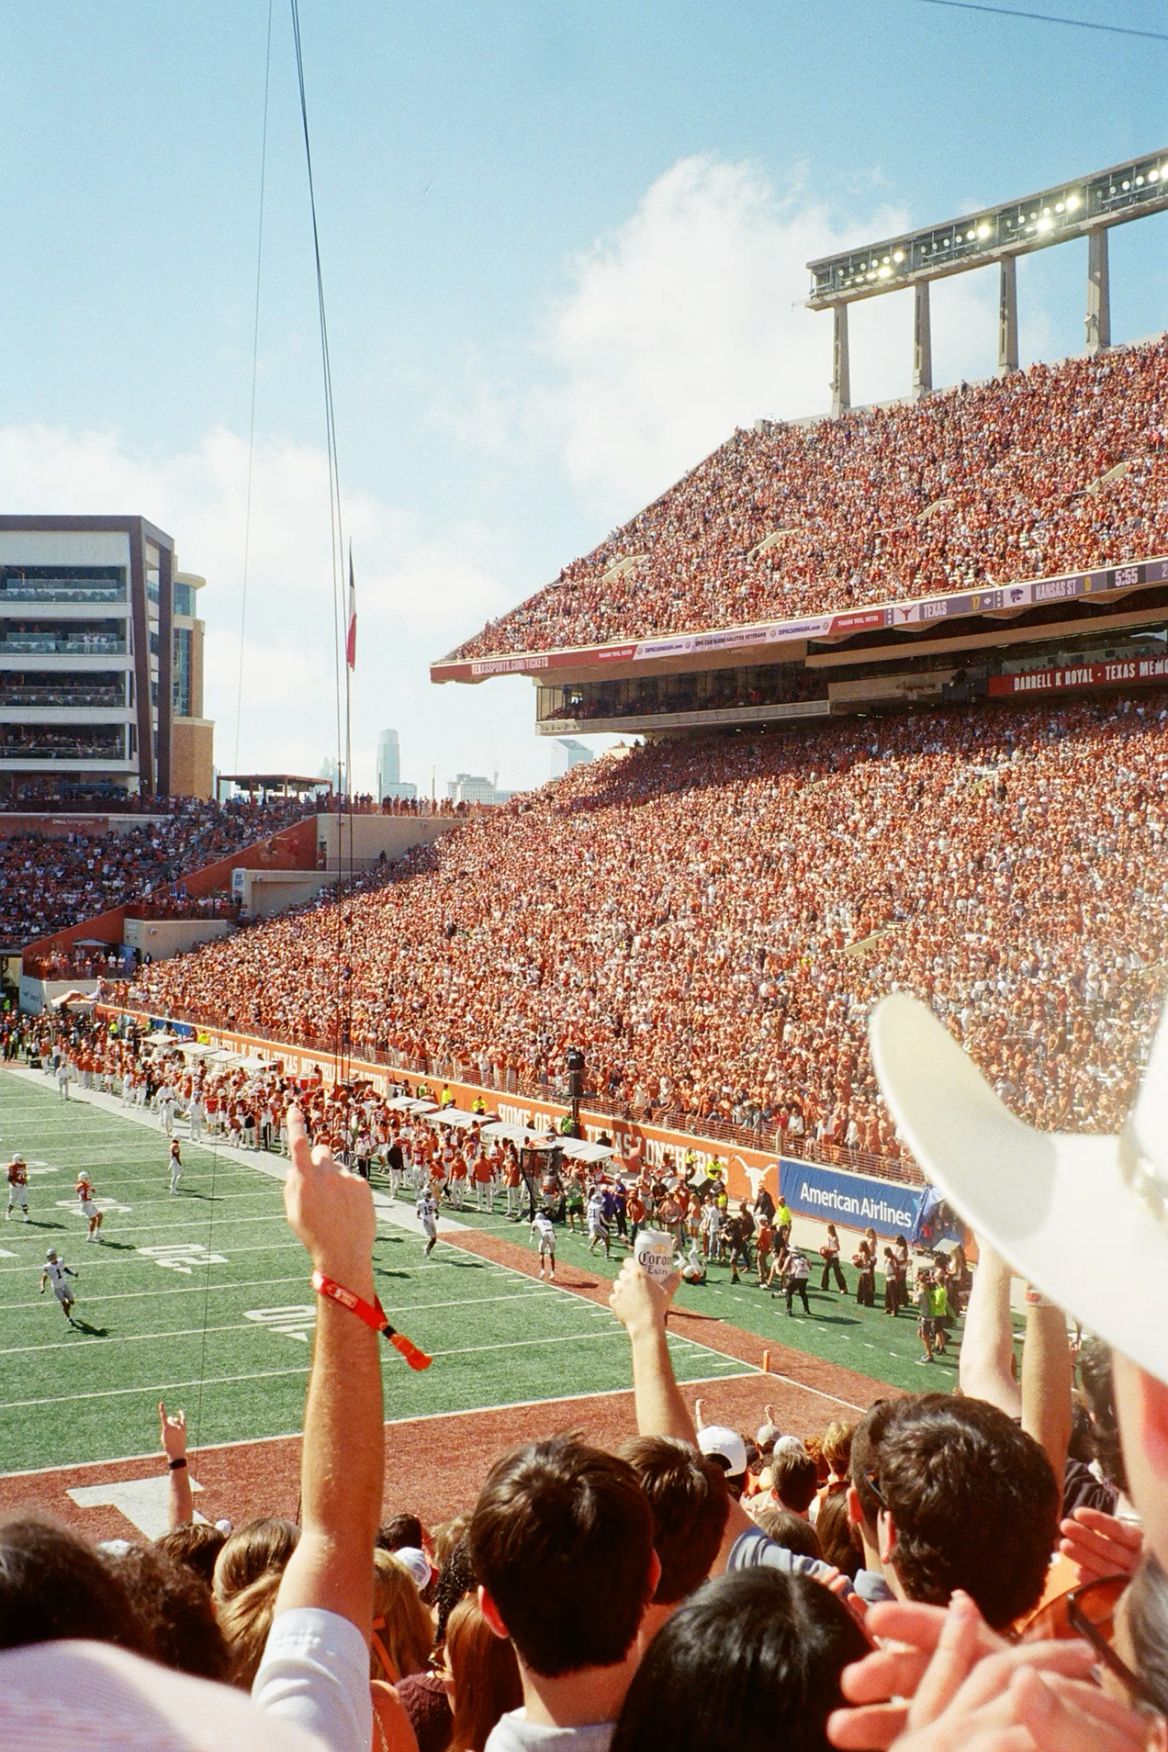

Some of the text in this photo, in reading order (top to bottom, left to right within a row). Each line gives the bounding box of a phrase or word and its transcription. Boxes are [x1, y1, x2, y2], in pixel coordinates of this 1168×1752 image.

[1115, 567, 1139, 587] 5:55
[1035, 581, 1066, 601] KANSAS
[1066, 579, 1077, 596] ST
[922, 601, 948, 618] TEXAS
[1013, 672, 1052, 691] DARRELL
[1055, 672, 1062, 686] K
[1065, 668, 1094, 685] ROYAL
[1105, 663, 1136, 680] TEXAS
[800, 1182, 912, 1228] American Airlines
[56, 1268, 62, 1279] 1
